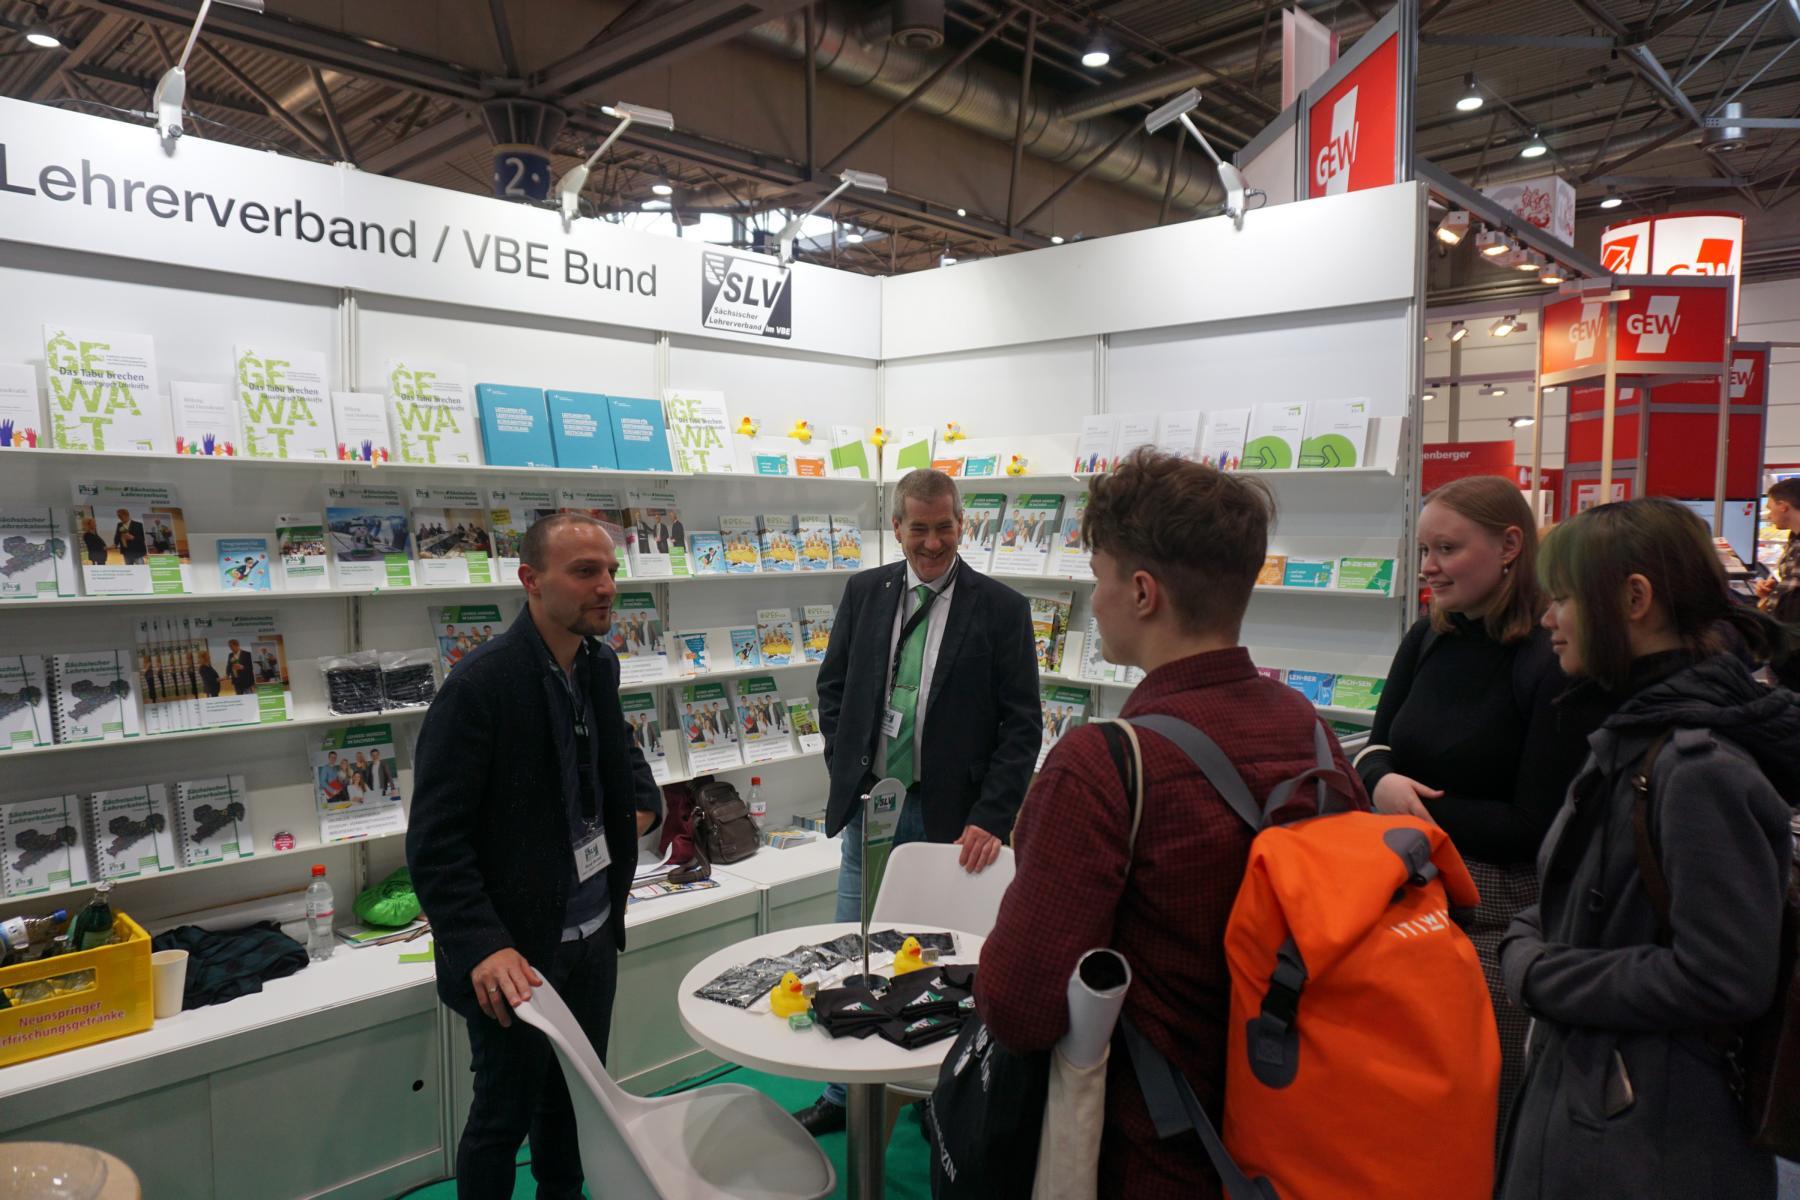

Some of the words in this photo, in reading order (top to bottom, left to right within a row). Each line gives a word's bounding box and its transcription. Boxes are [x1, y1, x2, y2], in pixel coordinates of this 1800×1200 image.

[1316, 121, 1359, 187] GEW
[505, 157, 526, 195] 2
[0, 143, 417, 259] Lehrerverband
[462, 229, 550, 280] VBE
[564, 249, 657, 297] Bund
[723, 271, 782, 309] SLV
[709, 316, 762, 331] Lehrerverband
[713, 306, 758, 320] Sächsischer
[1627, 313, 1681, 336] GEW
[775, 326, 791, 336] VBE
[1568, 316, 1604, 343] GEW
[59, 366, 78, 377] Das
[81, 368, 104, 379] Tabu
[106, 370, 145, 382] brechen
[19, 1001, 102, 1028] Neunspringer
[0, 1010, 125, 1048] rfrischungsgetränke
